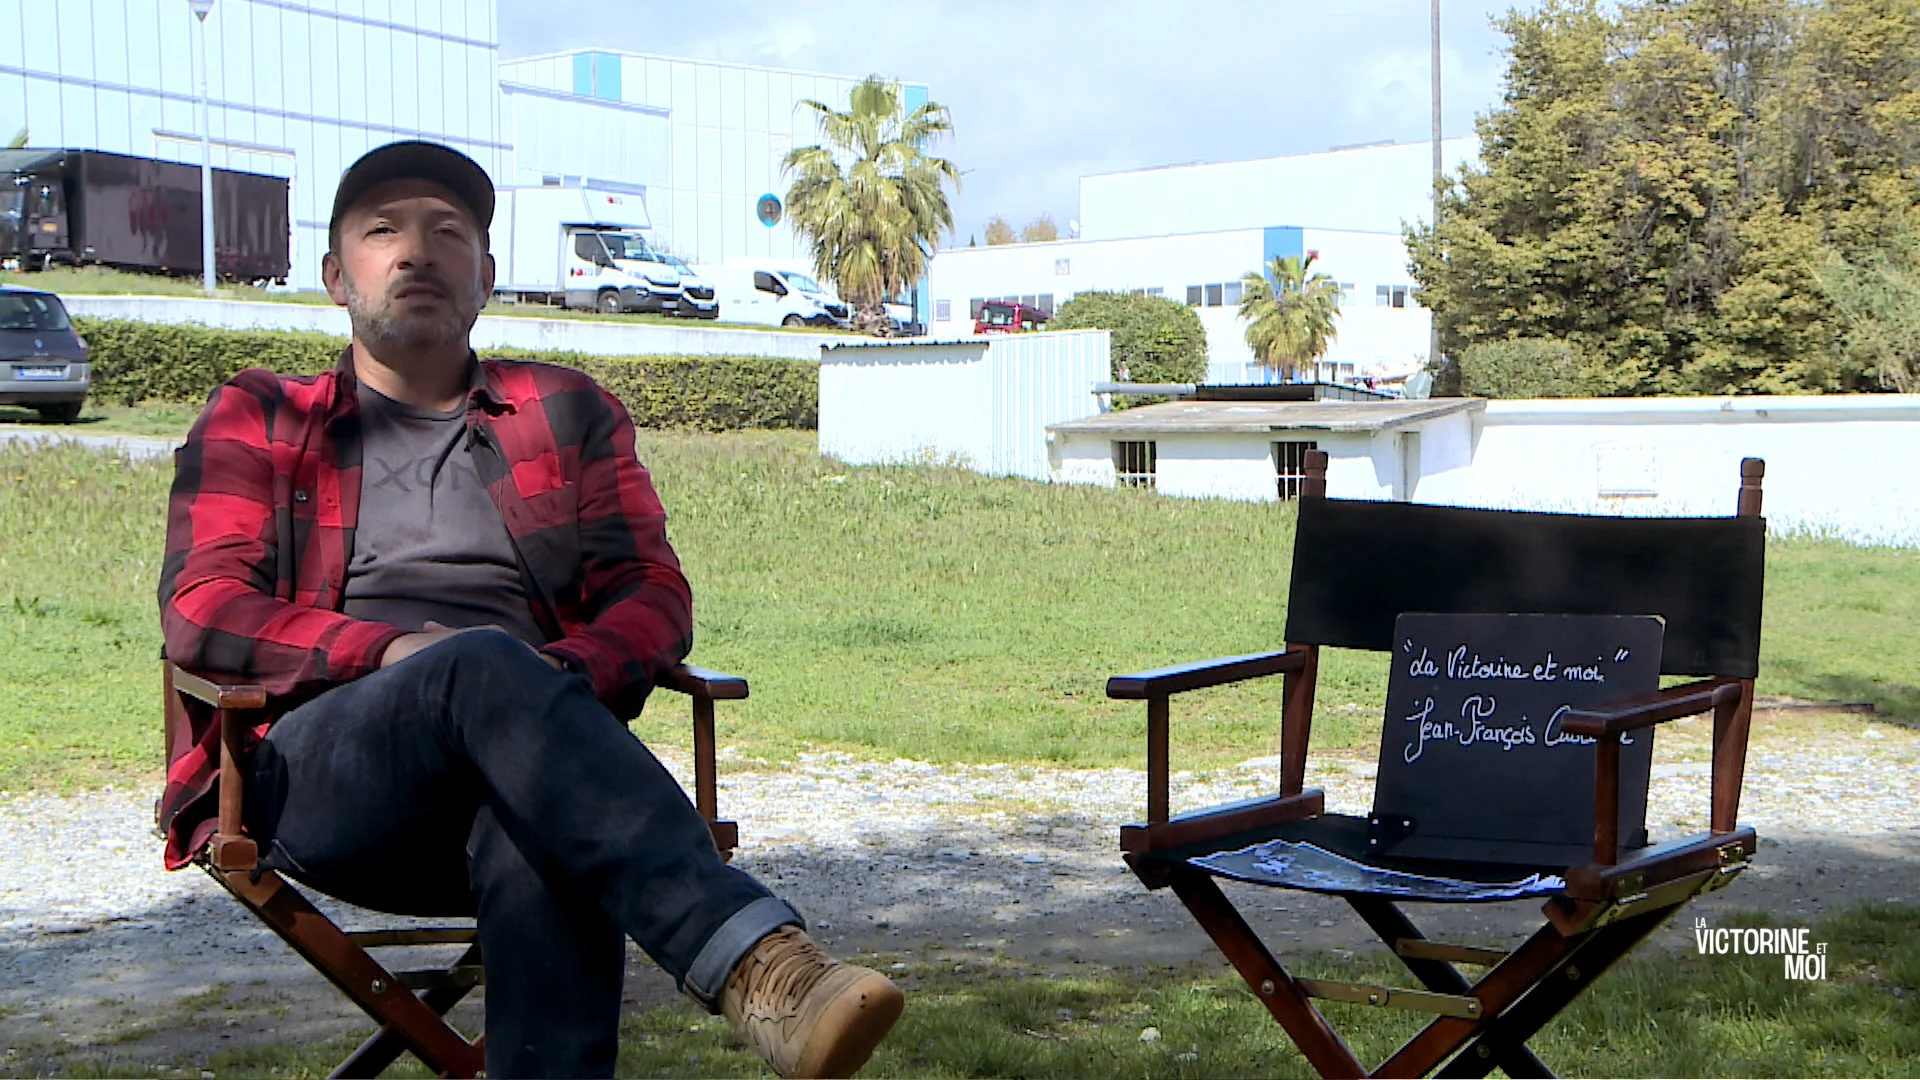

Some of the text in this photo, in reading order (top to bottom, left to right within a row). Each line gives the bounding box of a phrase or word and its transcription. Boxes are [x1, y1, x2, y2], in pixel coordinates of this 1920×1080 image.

[1448, 645, 1530, 679] Victorine
[1533, 652, 1559, 681] et
[1404, 696, 1537, 763] Jean-François
